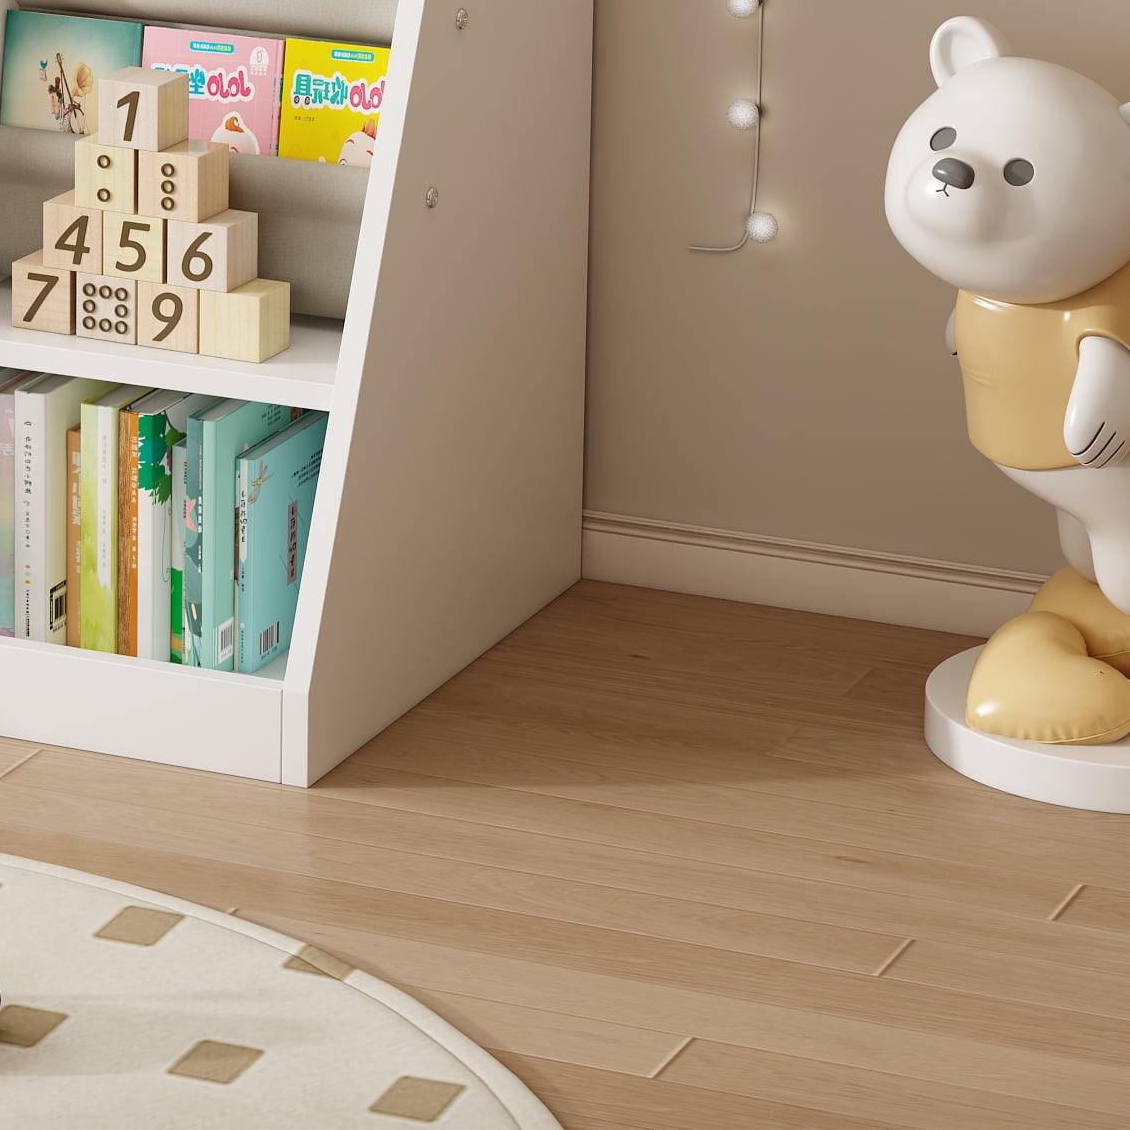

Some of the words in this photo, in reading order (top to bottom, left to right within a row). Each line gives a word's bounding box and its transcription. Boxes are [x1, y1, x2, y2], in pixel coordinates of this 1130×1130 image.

[116, 90, 140, 142] 1
[54, 215, 91, 265] 4
[115, 220, 151, 272] 5
[181, 231, 213, 282] 6
[22, 272, 59, 323] 7
[151, 292, 183, 342] 9
